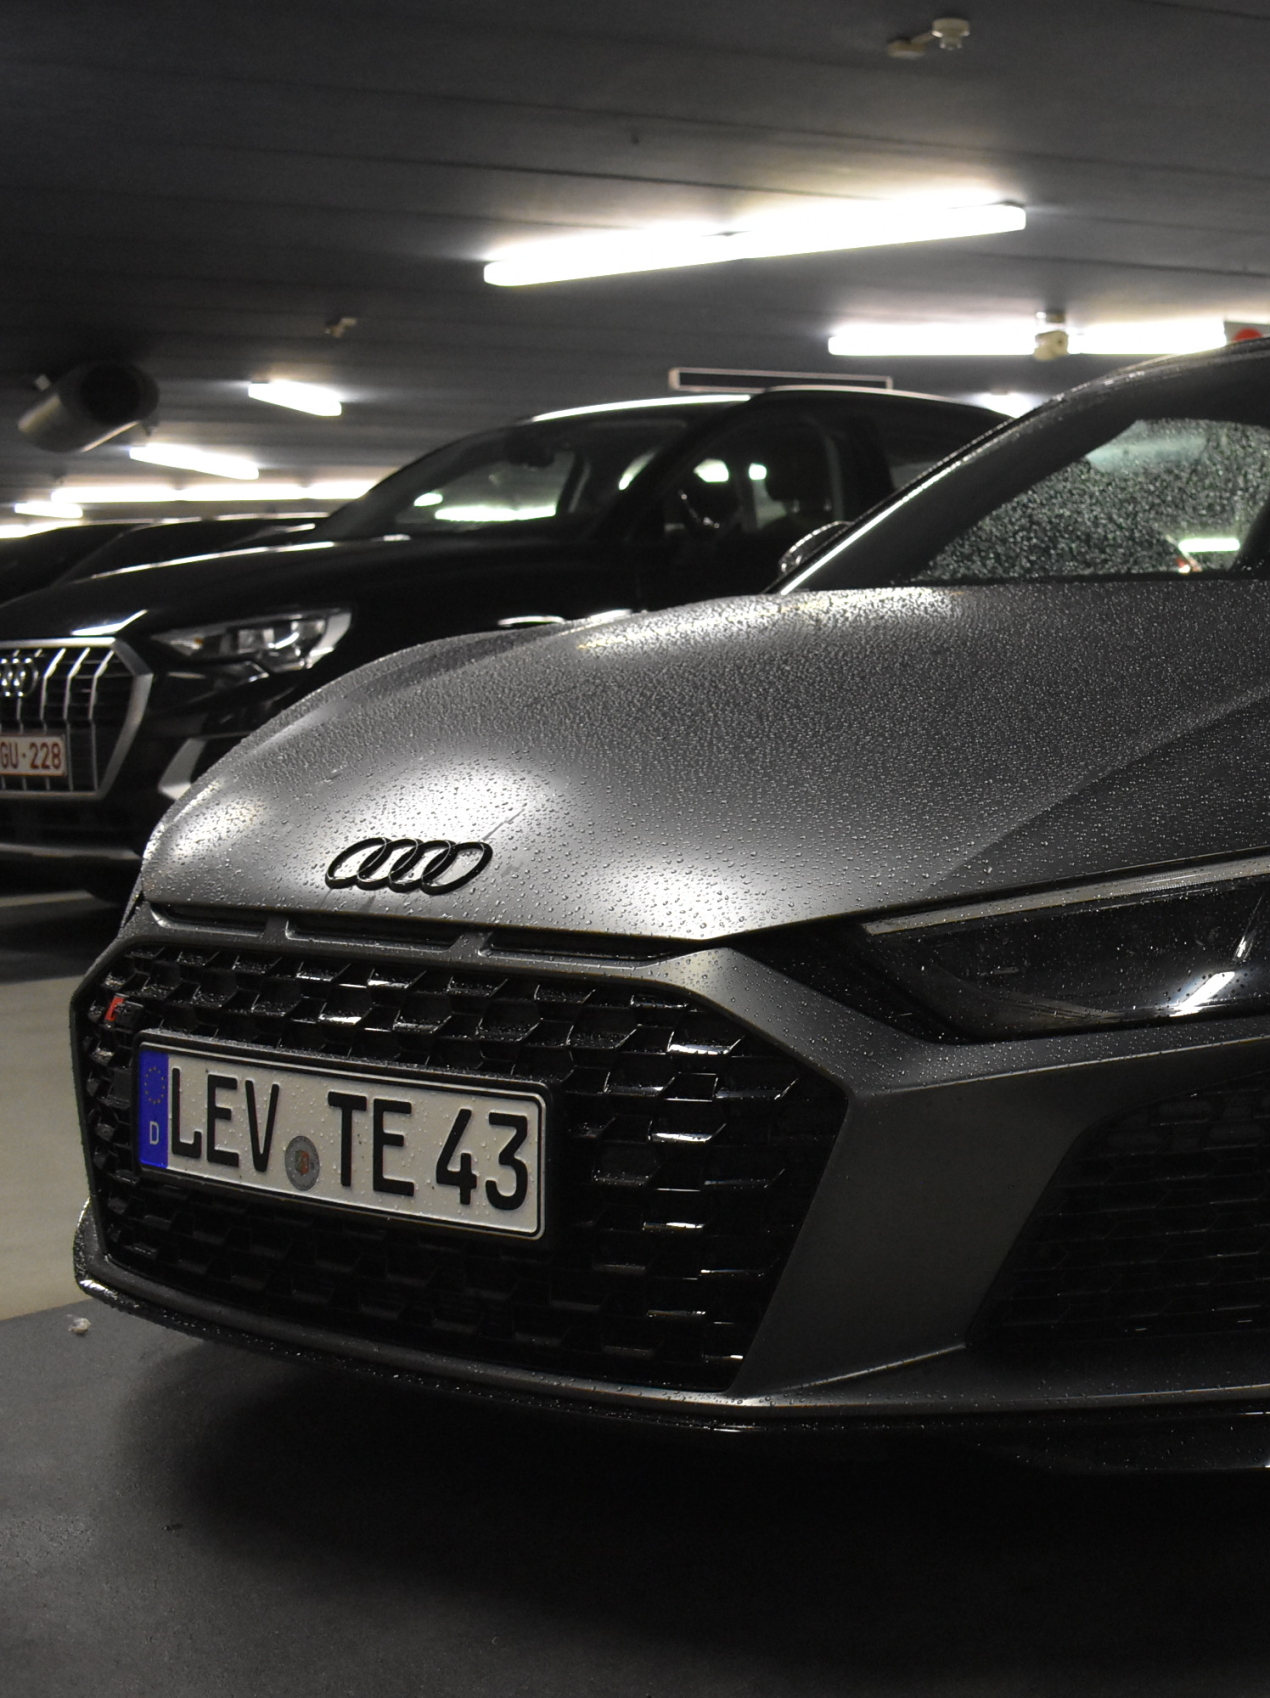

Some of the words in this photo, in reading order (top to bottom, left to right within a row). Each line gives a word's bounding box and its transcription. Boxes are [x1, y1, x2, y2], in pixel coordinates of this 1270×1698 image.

[148, 1120, 160, 1146] D
[170, 1066, 280, 1173] LEV
[327, 1090, 415, 1197] TE
[435, 1107, 529, 1212] 43
